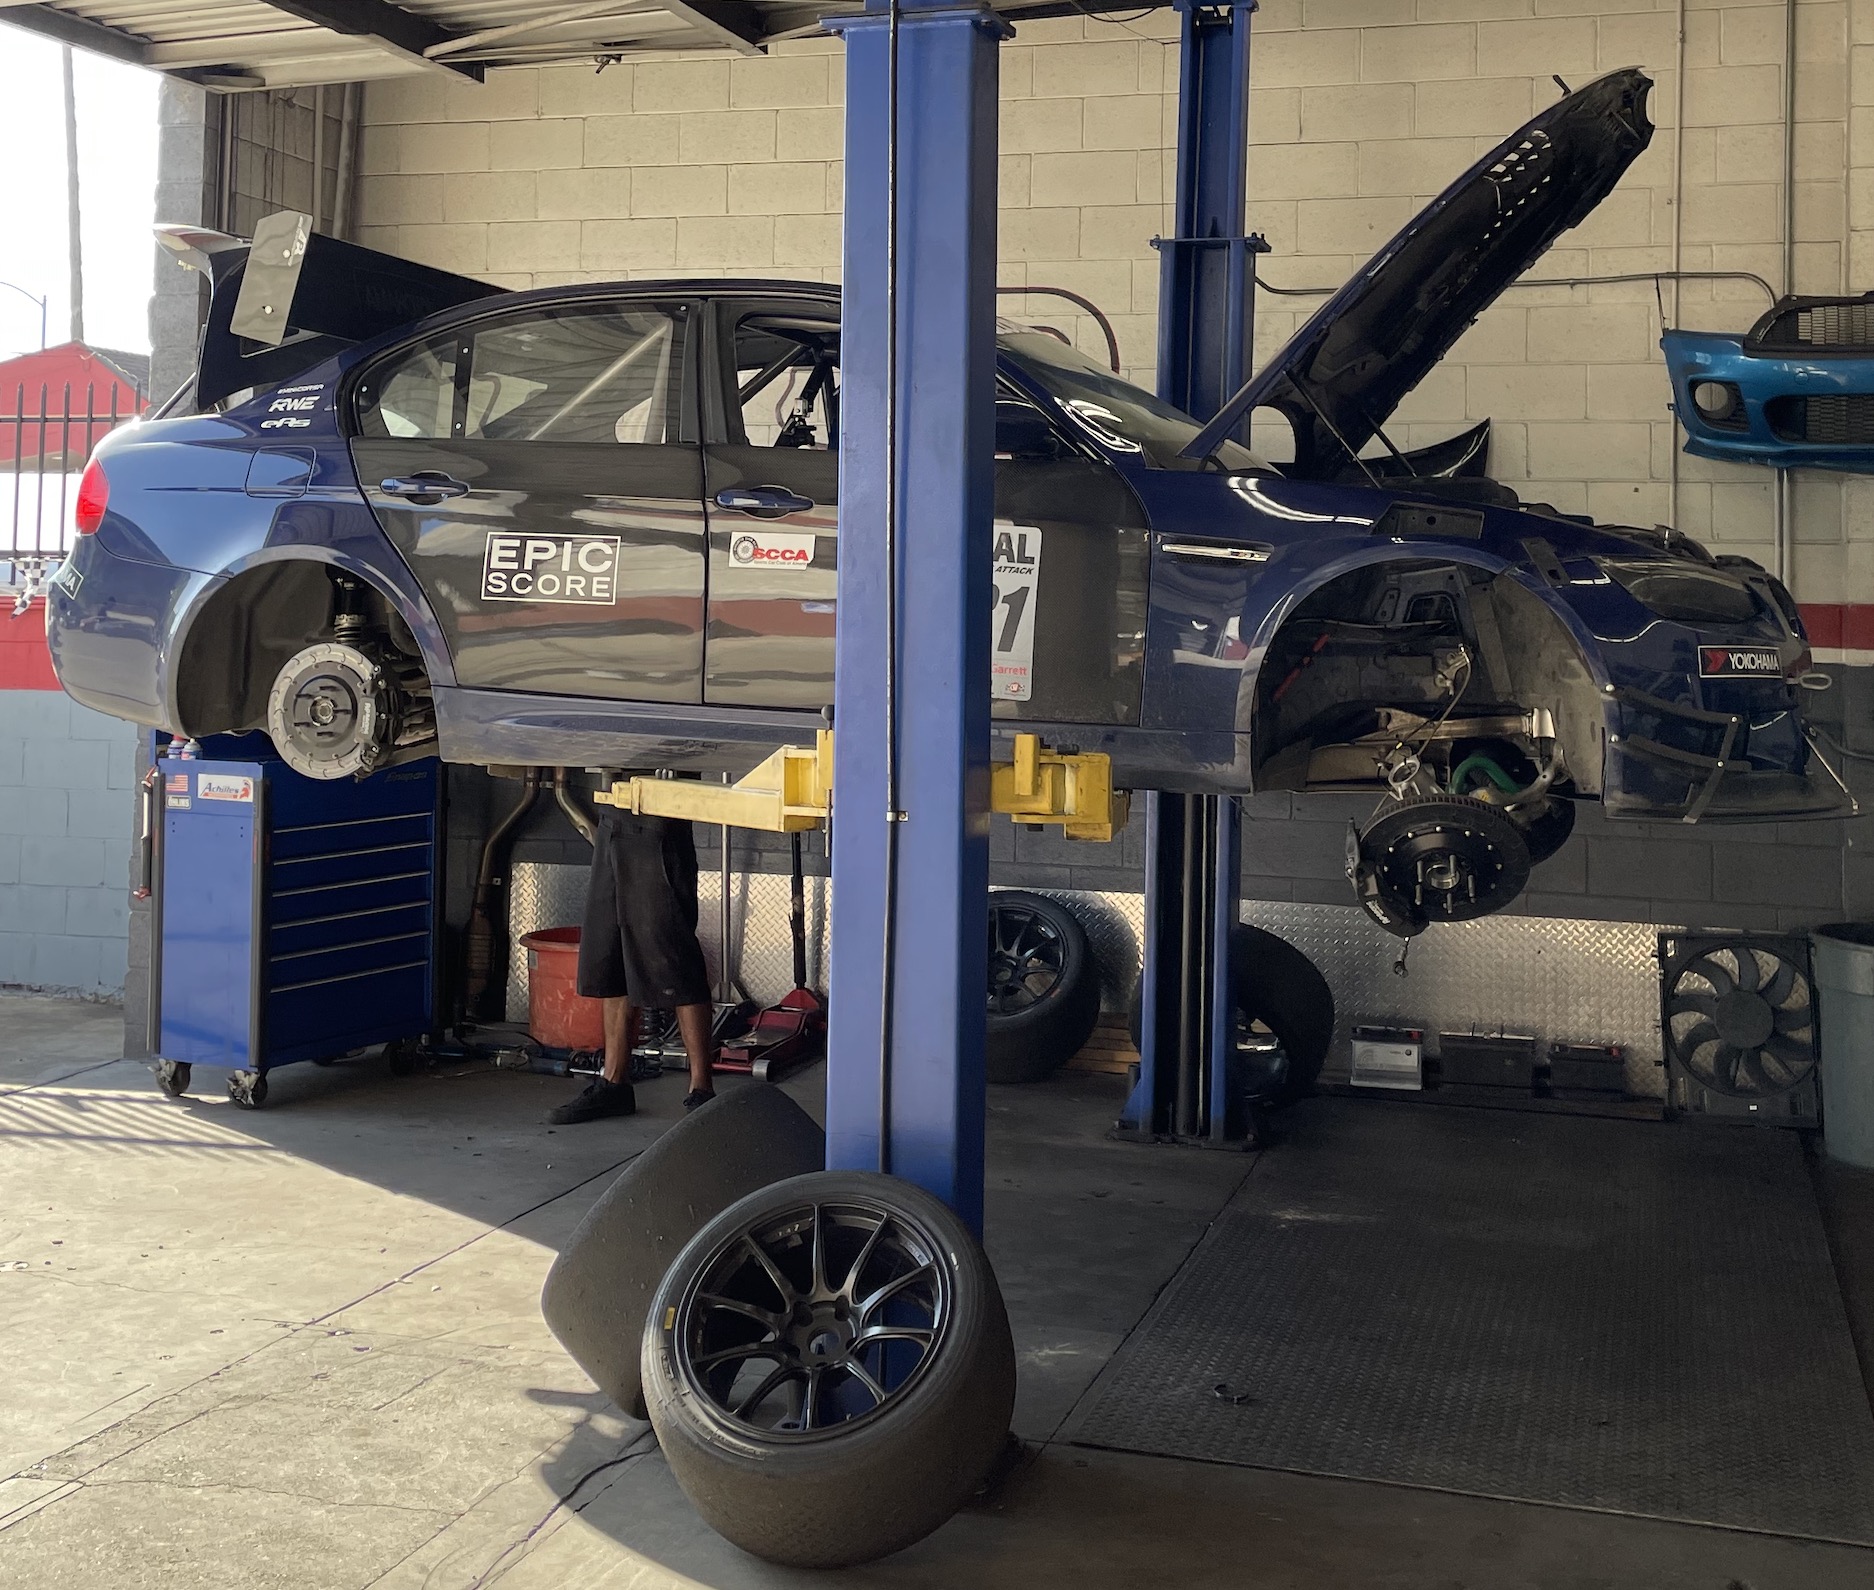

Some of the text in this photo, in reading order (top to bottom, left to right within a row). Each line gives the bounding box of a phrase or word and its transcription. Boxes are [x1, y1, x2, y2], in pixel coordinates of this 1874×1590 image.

[268, 395, 320, 412] RWE
[489, 538, 613, 573] EPIC
[753, 548, 809, 561] SCCA
[993, 532, 1034, 564] AL
[995, 566, 1034, 575] ATTACK
[487, 572, 610, 597] SCORE
[992, 584, 1030, 652] 1
[1728, 653, 1779, 670] YOKOHAMA
[200, 782, 239, 797] Achilles
